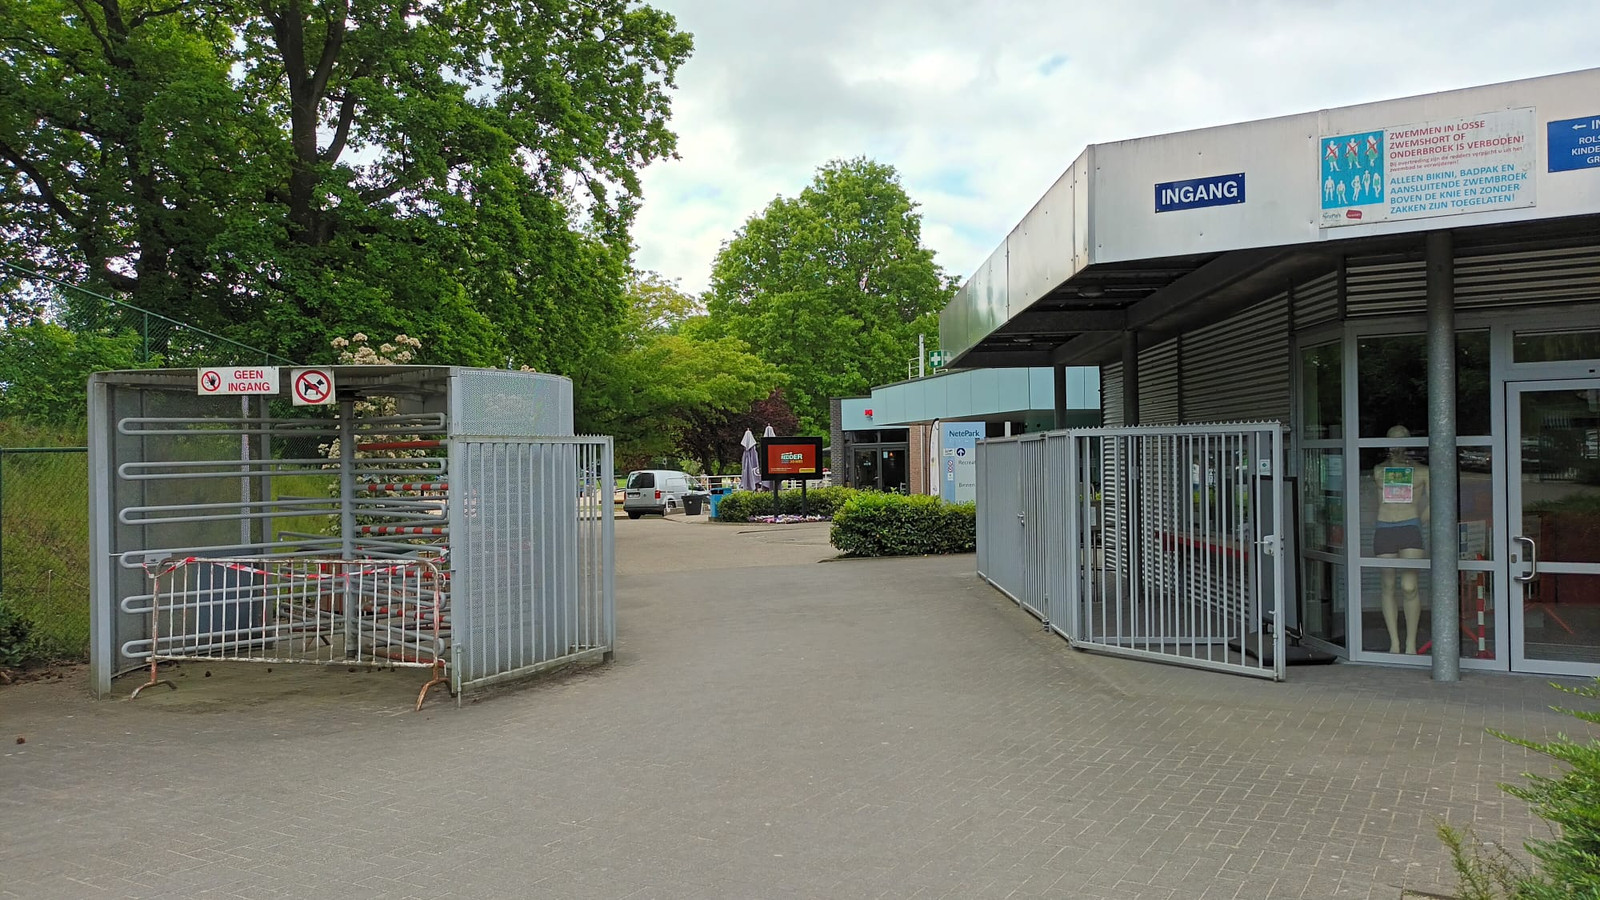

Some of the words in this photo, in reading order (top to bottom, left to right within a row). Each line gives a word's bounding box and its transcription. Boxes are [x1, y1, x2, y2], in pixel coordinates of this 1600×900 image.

[1390, 126, 1442, 140] ZWEMMEN
[1444, 124, 1454, 132] IN
[1456, 120, 1486, 132] LOSSE
[1390, 136, 1450, 150] ZWEMSHORT
[1453, 133, 1466, 141] OF
[1390, 144, 1454, 160] ONDERBROEK
[1456, 142, 1464, 152] IS
[1467, 136, 1524, 150] VERBODEN!
[1572, 146, 1600, 156] KINDE
[1586, 156, 1600, 164] GR
[1398, 158, 1430, 166] overtreding
[1390, 174, 1424, 185] ALLEEN
[1426, 170, 1457, 181] BIKINI,
[1460, 166, 1498, 177] BADPAK
[1502, 164, 1514, 172] EN
[1390, 180, 1460, 194] AANSLUITENDE
[1463, 172, 1527, 186] ZWEMBROEK
[1162, 181, 1238, 205] INGANG
[1390, 194, 1422, 204] BOVEN
[1424, 192, 1437, 200] DE
[1440, 190, 1460, 199] KNIE
[1464, 188, 1476, 196] EN
[1480, 183, 1520, 194] ZONDER
[1390, 204, 1426, 214] ZAKKEN
[1428, 202, 1448, 210] ZIJN
[1452, 194, 1515, 208] TOEGELATEN!
[234, 370, 264, 380] GEEN
[228, 382, 270, 392] INGANG
[948, 430, 980, 438] NetePark
